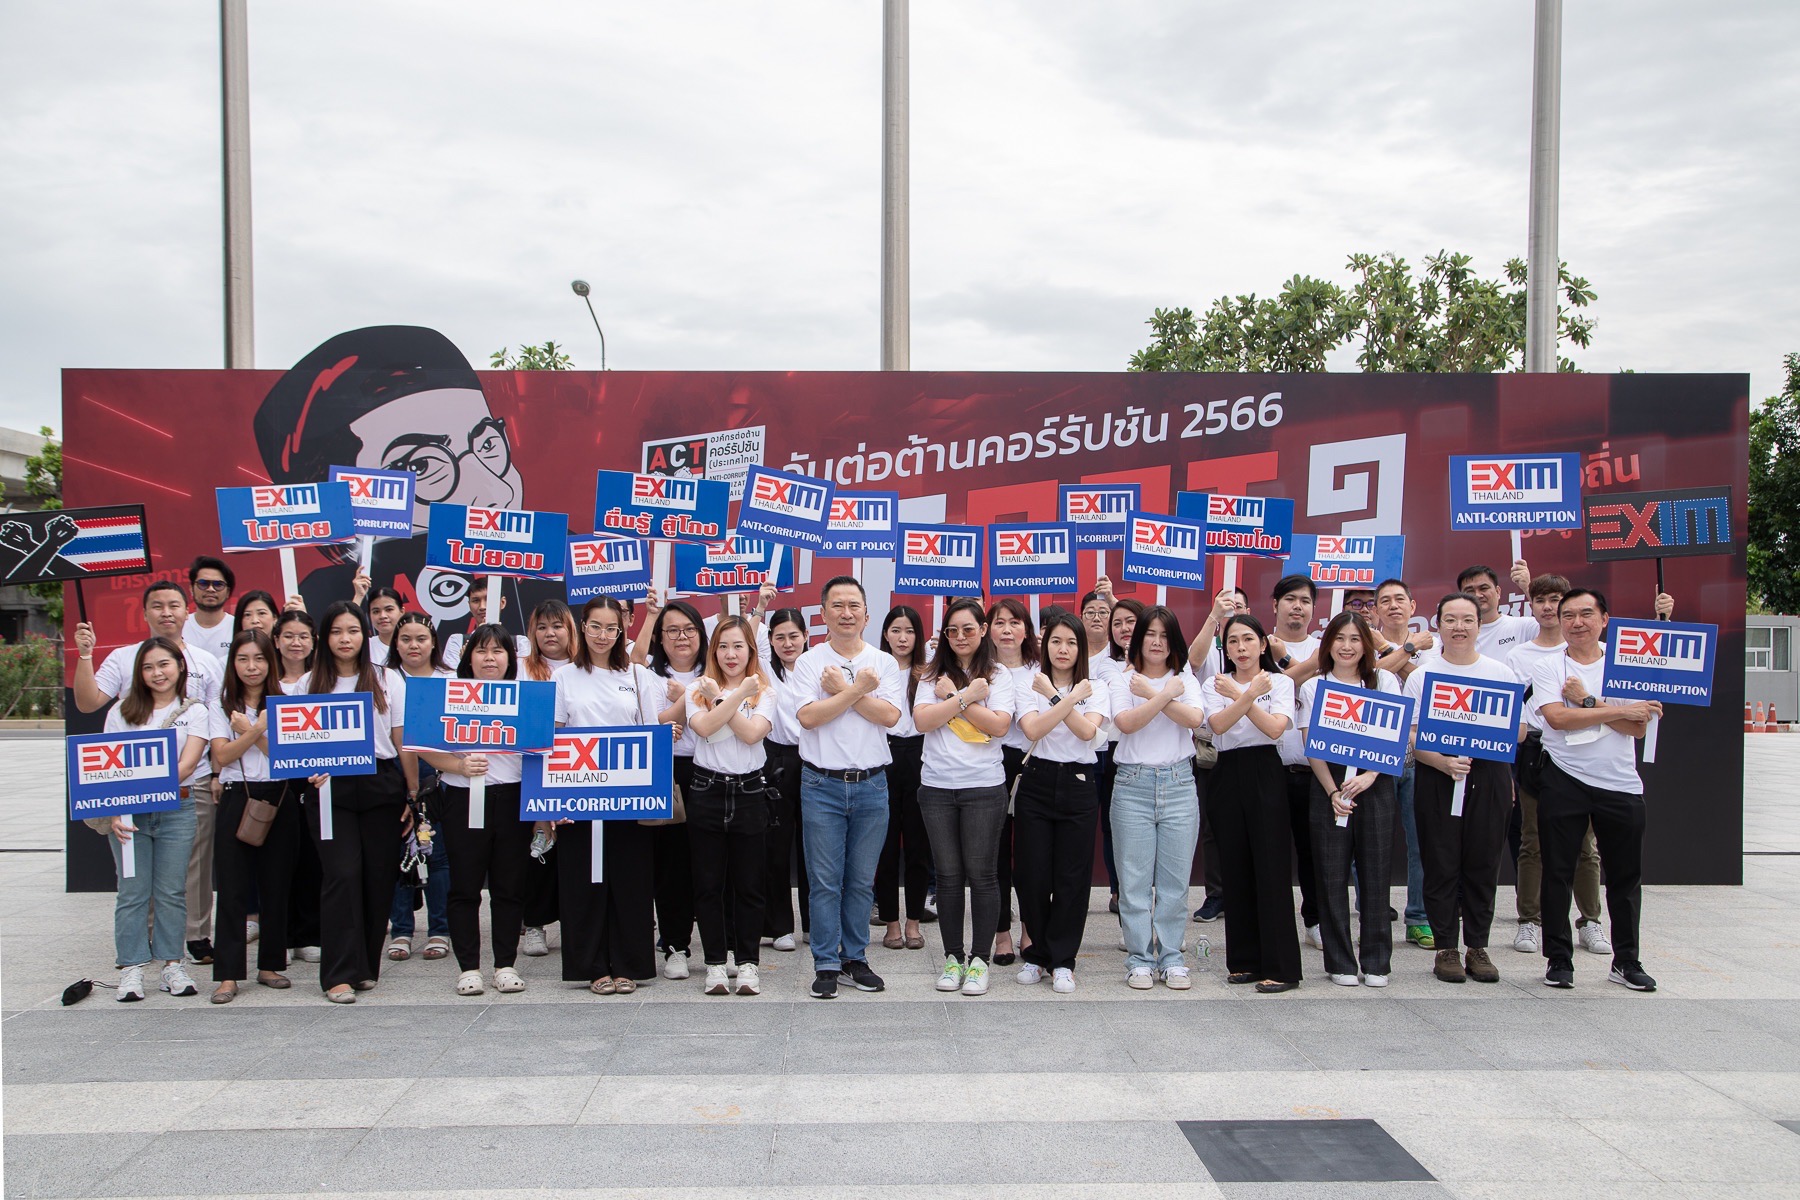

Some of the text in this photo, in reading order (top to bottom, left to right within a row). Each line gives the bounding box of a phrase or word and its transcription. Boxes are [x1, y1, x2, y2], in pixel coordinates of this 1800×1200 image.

[1181, 392, 1283, 439] 2566
[710, 429, 760, 444] องค์กรต่อต้าน
[649, 441, 705, 471] ACT
[709, 469, 748, 480] ANTI-CORRUPT
[1472, 462, 1557, 490] EXIM
[255, 486, 316, 508] EXIM
[340, 475, 404, 501] EXIM
[634, 476, 696, 501] EXIM
[754, 476, 823, 511] EXIM
[1472, 491, 1524, 501] THAILAND
[257, 506, 294, 515] THAILAND
[351, 497, 378, 506] AILAND
[634, 496, 671, 507] THAILAND
[754, 498, 794, 514] THAILAND
[829, 500, 888, 521] EXIM
[1070, 493, 1134, 514] EXIM
[1210, 497, 1263, 518] EXIM
[353, 518, 410, 531] CORRUPTION
[468, 508, 531, 534] EXIM
[603, 506, 719, 538] ตื่นรู้ สู้โกง
[828, 521, 864, 529] THAILAND
[1209, 515, 1241, 523] THAILAND
[1456, 510, 1576, 524] ANTI-CORRUPTION
[1589, 496, 1730, 550] EXIM
[242, 518, 332, 543] ไม่เฉย
[468, 529, 506, 539] THAILAND
[740, 518, 823, 545] ANTI-CORRUPTION
[1076, 534, 1125, 544] TI-CORRUPT
[1135, 521, 1197, 550] EXIM
[1206, 528, 1282, 551] มปราบโกง
[708, 536, 762, 556] EXIM
[836, 541, 858, 551] GIFT
[861, 541, 895, 552] POLICY
[907, 533, 973, 557] EXIM
[1000, 532, 1066, 555] EXIM
[1135, 542, 1172, 554] THAILAND
[1318, 537, 1373, 554] EXIM
[447, 539, 544, 570] ไม่ยอม
[574, 541, 639, 566] EXIM
[907, 555, 947, 564] THAILAND
[1000, 554, 1040, 563] THAILAND
[576, 563, 615, 573] THAILAND
[1126, 564, 1202, 582] ANTI-CORRUPTION
[1308, 561, 1375, 583] ไม่ทน
[570, 582, 650, 597] ANTI-CORRUPTION
[898, 577, 979, 589] ANTI-CORRUPTION
[993, 576, 1075, 587] ANTI-CORRUPTION
[1620, 630, 1703, 660] EXIM
[1619, 655, 1668, 666] THAILAND
[448, 682, 517, 705] EXIM
[1606, 679, 1708, 697] ANTI-CORRUPTION
[449, 704, 489, 713] THAILAND
[1433, 684, 1511, 718] EXIM
[281, 704, 361, 732] EXIM
[1324, 692, 1401, 730] EXIM
[1432, 708, 1478, 722] THAILAND
[440, 716, 517, 746] ไม่ทำ
[1323, 717, 1368, 733] THAILAND
[282, 731, 331, 741] THAILAND
[1420, 731, 1513, 753] NO GIFT POLICY
[82, 741, 164, 772] EXIM
[273, 755, 372, 769] ANTI-CORRUPTION
[548, 736, 648, 771] EXIM
[1309, 738, 1401, 767] NO GIFT POLICY
[83, 769, 133, 781] THAILAND
[548, 772, 609, 783] THAILAND
[75, 791, 177, 810] ANTI-CORRUPTION
[526, 796, 667, 812] ANTI-CORRUPTION
